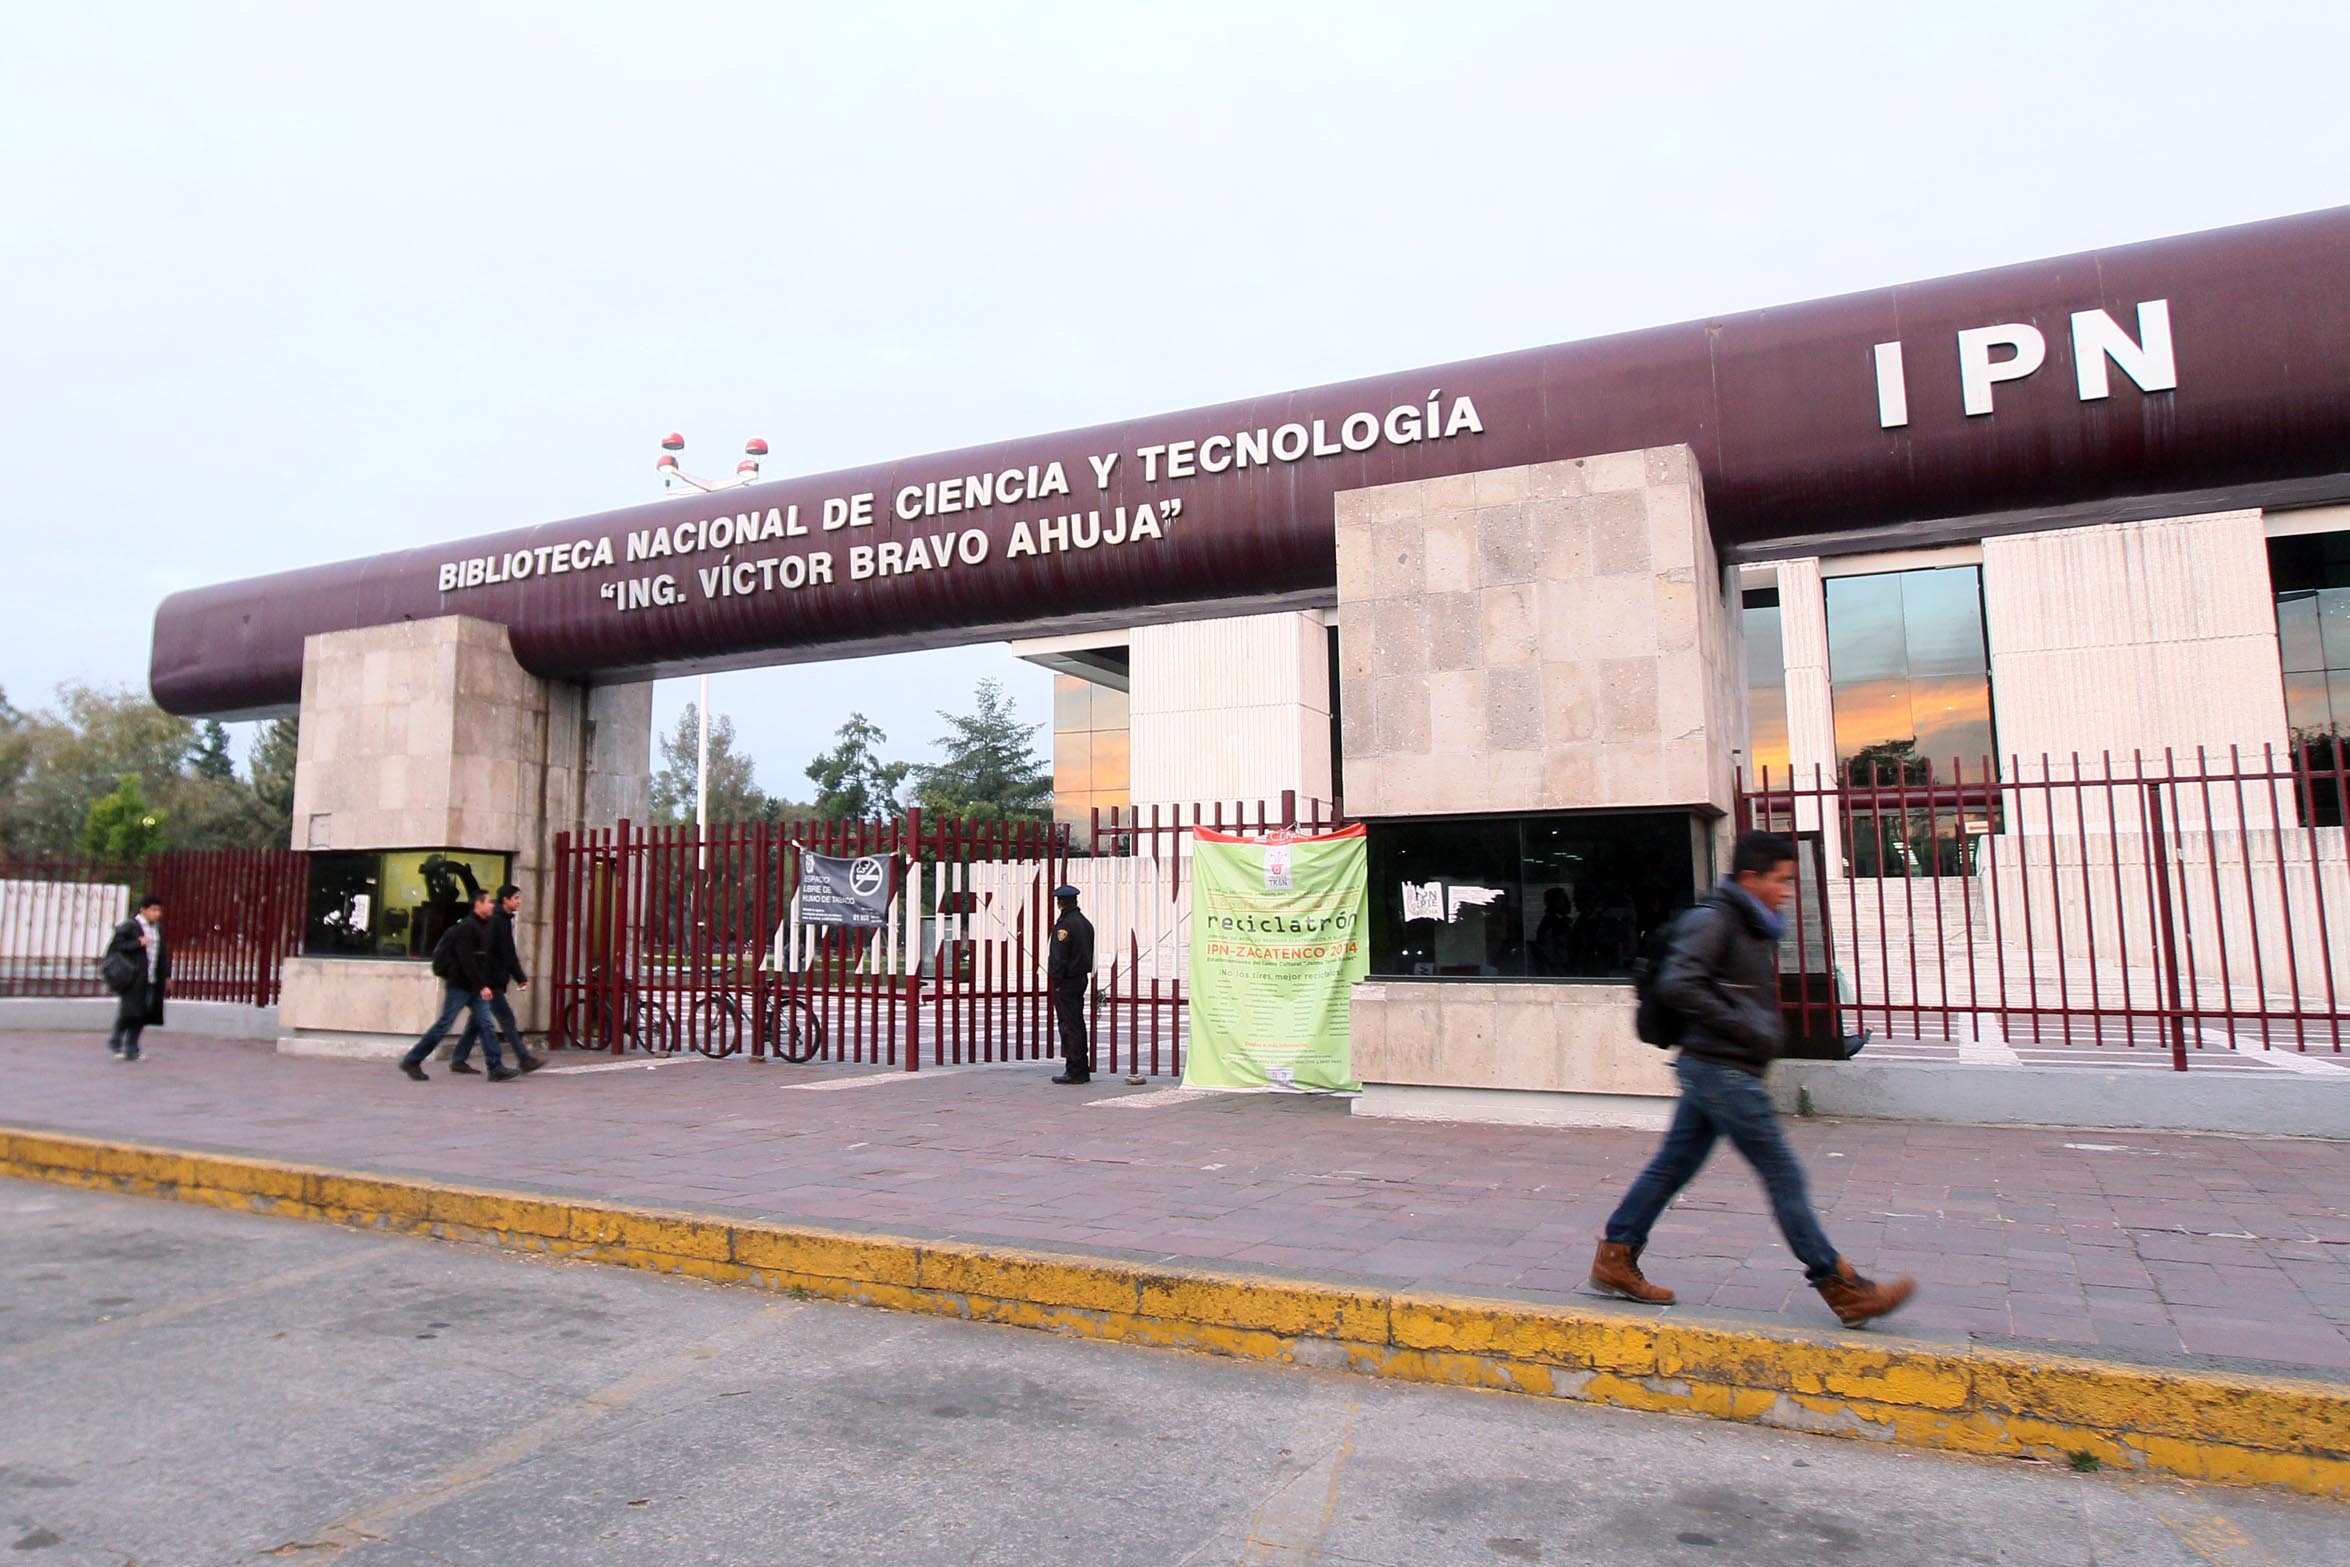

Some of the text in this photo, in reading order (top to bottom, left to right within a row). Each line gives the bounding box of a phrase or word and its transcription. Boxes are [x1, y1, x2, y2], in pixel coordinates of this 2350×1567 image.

[1873, 298, 2178, 429] IPN
[437, 388, 1485, 592] BIBLIOTECA NACIONAL DE CIENCIA Y TECNOLOGÍA
[697, 553, 833, 599] VÍCTOR
[849, 528, 990, 581] BRAVO
[822, 885, 832, 894] DE
[1207, 910, 1358, 933] reciclatrón
[1206, 942, 1358, 960] IPN-ZACATENCO 2014
[1275, 973, 1302, 982] mejor
